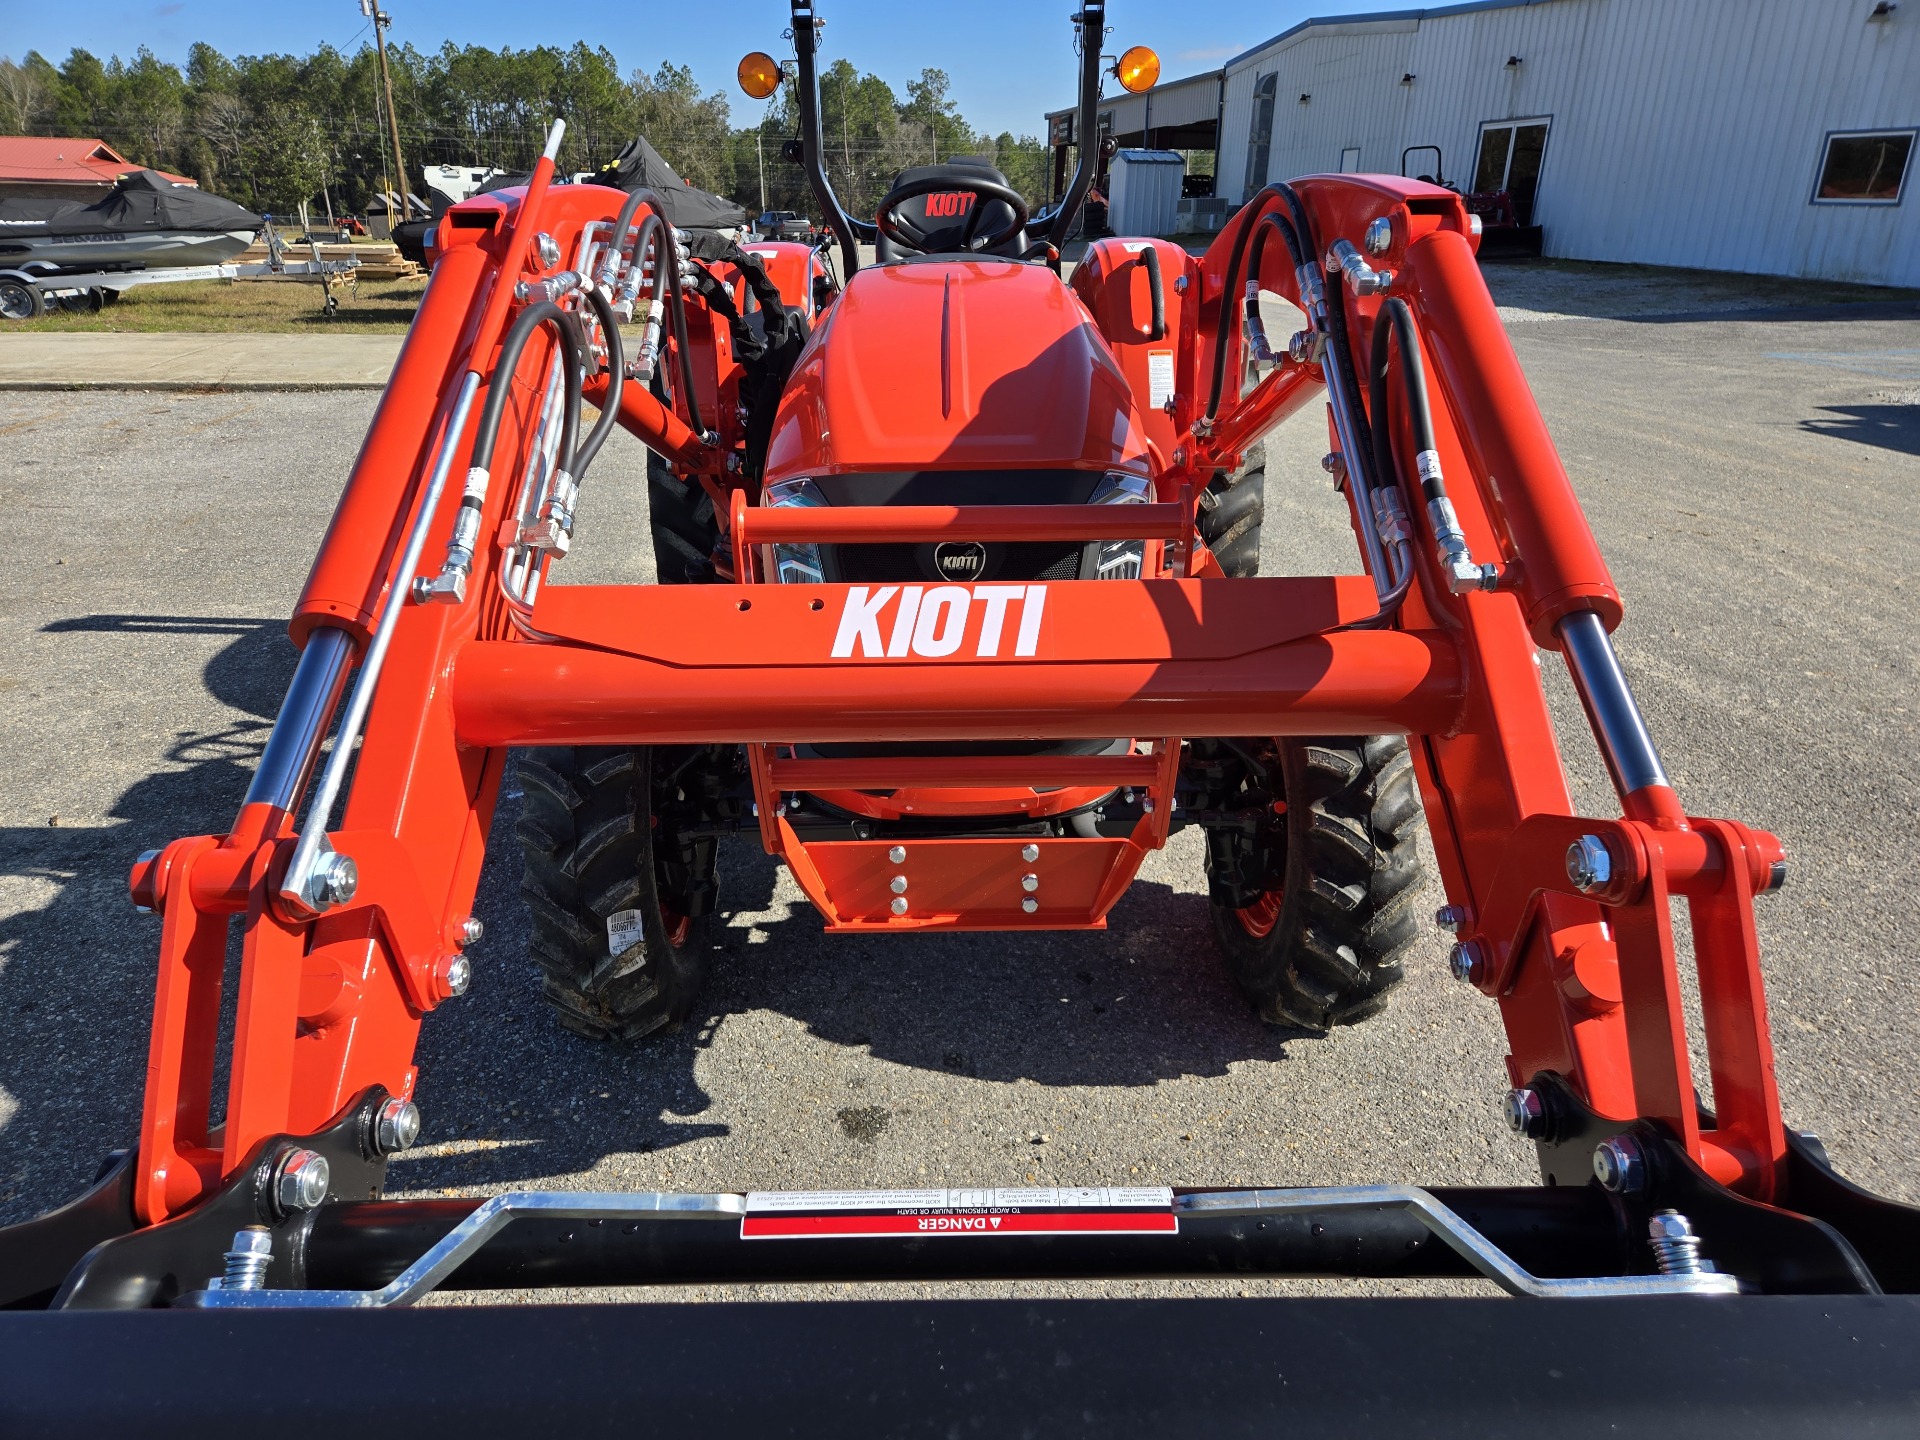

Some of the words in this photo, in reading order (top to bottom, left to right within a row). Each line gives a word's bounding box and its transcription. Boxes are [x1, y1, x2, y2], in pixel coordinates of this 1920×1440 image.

[943, 556, 977, 570] KIOTI
[831, 586, 1046, 657] KIOTI
[918, 1218, 986, 1230] DANGER
